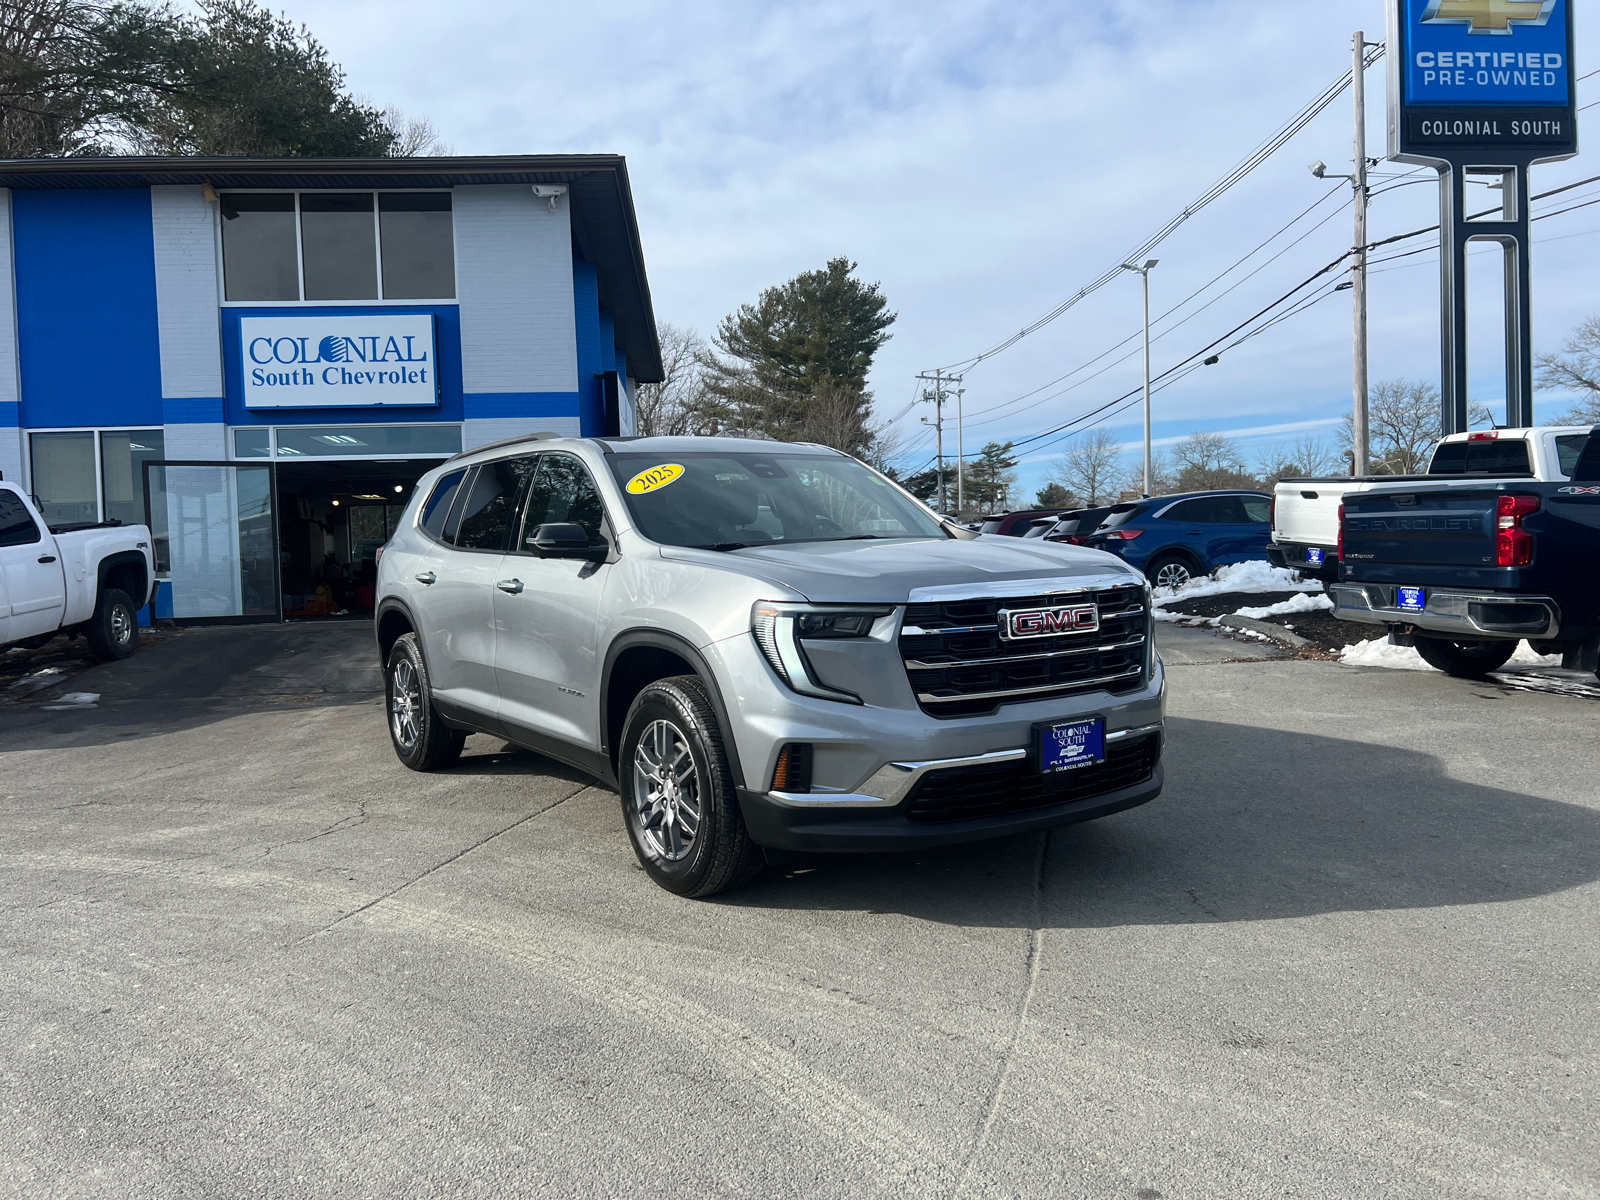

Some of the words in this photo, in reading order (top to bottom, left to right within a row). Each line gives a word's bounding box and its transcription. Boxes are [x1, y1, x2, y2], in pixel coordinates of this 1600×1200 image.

[1416, 51, 1562, 69] CERTIFIED
[1424, 70, 1556, 86] PRE-OWNED
[1421, 120, 1501, 136] COLONIAL
[1511, 121, 1561, 136] SOUTH
[249, 335, 427, 365] COLONIAL
[252, 367, 315, 386] South
[322, 365, 428, 386] Chevrolet
[636, 465, 674, 490] 2025
[1347, 518, 1480, 531] CHEVROLET
[1012, 608, 1097, 635] GMC
[1053, 726, 1091, 739] COLONIAL
[1059, 735, 1085, 747] SOUTH
